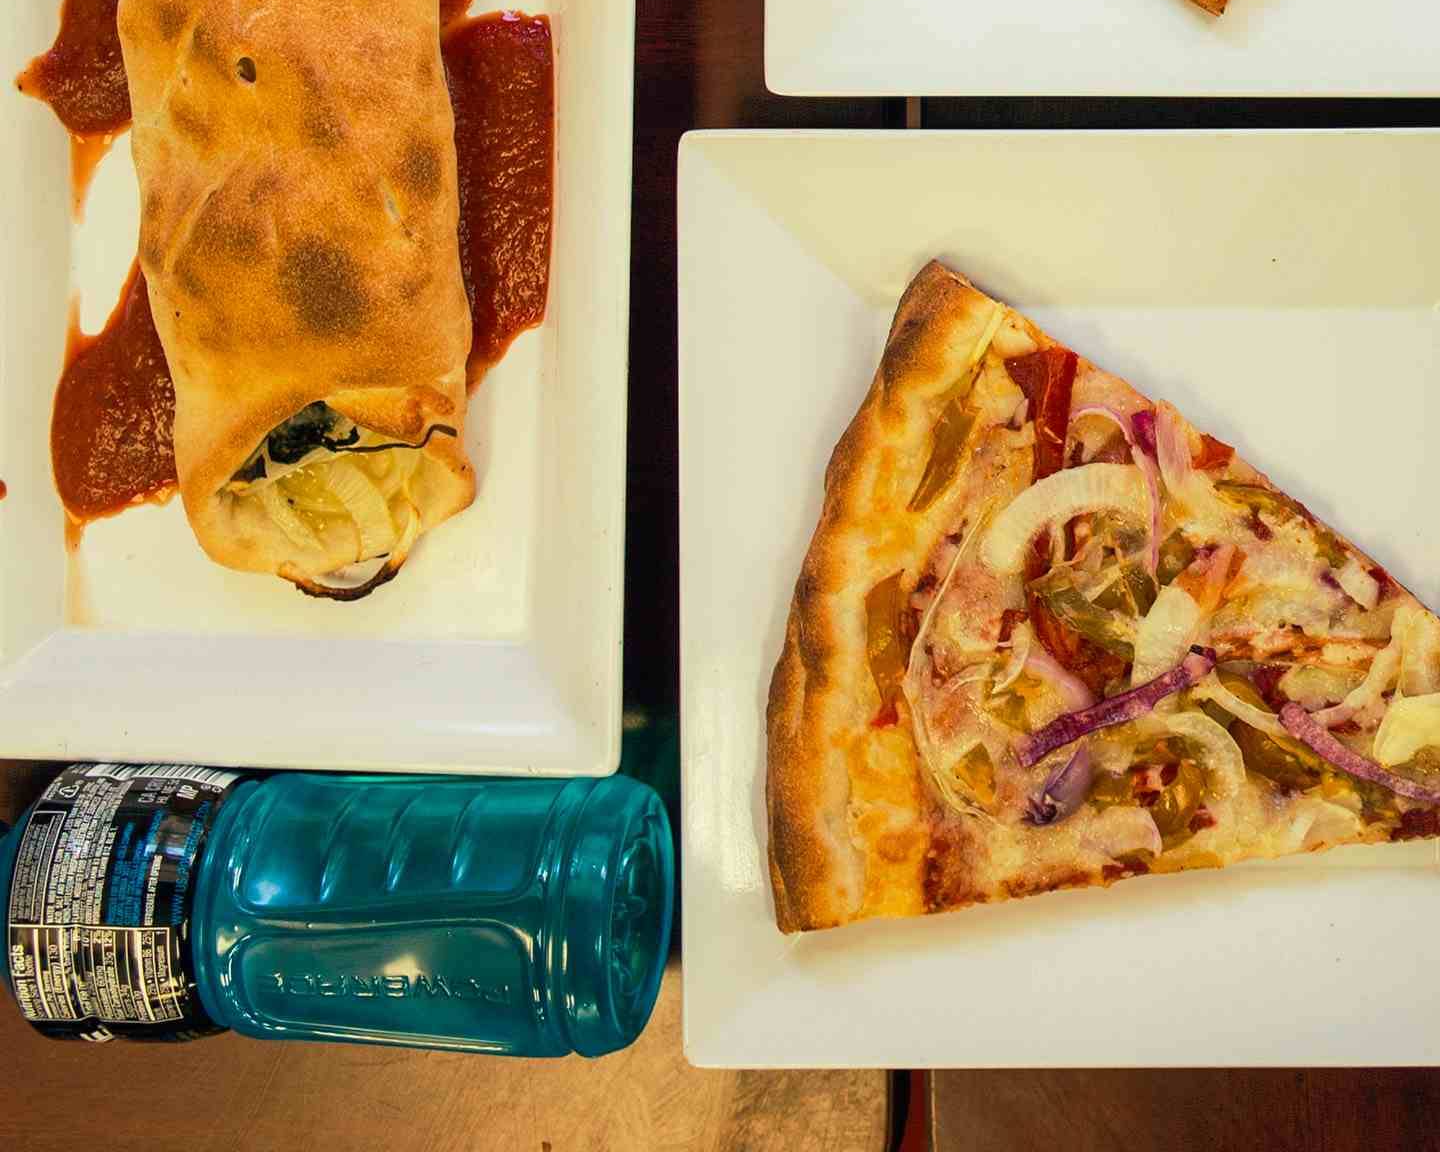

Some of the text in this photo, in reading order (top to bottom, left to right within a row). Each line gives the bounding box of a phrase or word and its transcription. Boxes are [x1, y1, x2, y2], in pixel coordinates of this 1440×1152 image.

[137, 792, 157, 803] CA
[176, 784, 198, 799] MP
[144, 855, 162, 926] REFRIGERATE AFTER OPENING
[104, 931, 112, 946] 12%
[49, 944, 58, 959] 130
[25, 954, 35, 976] Bottle
[11, 944, 37, 1017] Nutrition Facts
[52, 962, 64, 993] (Energy)
